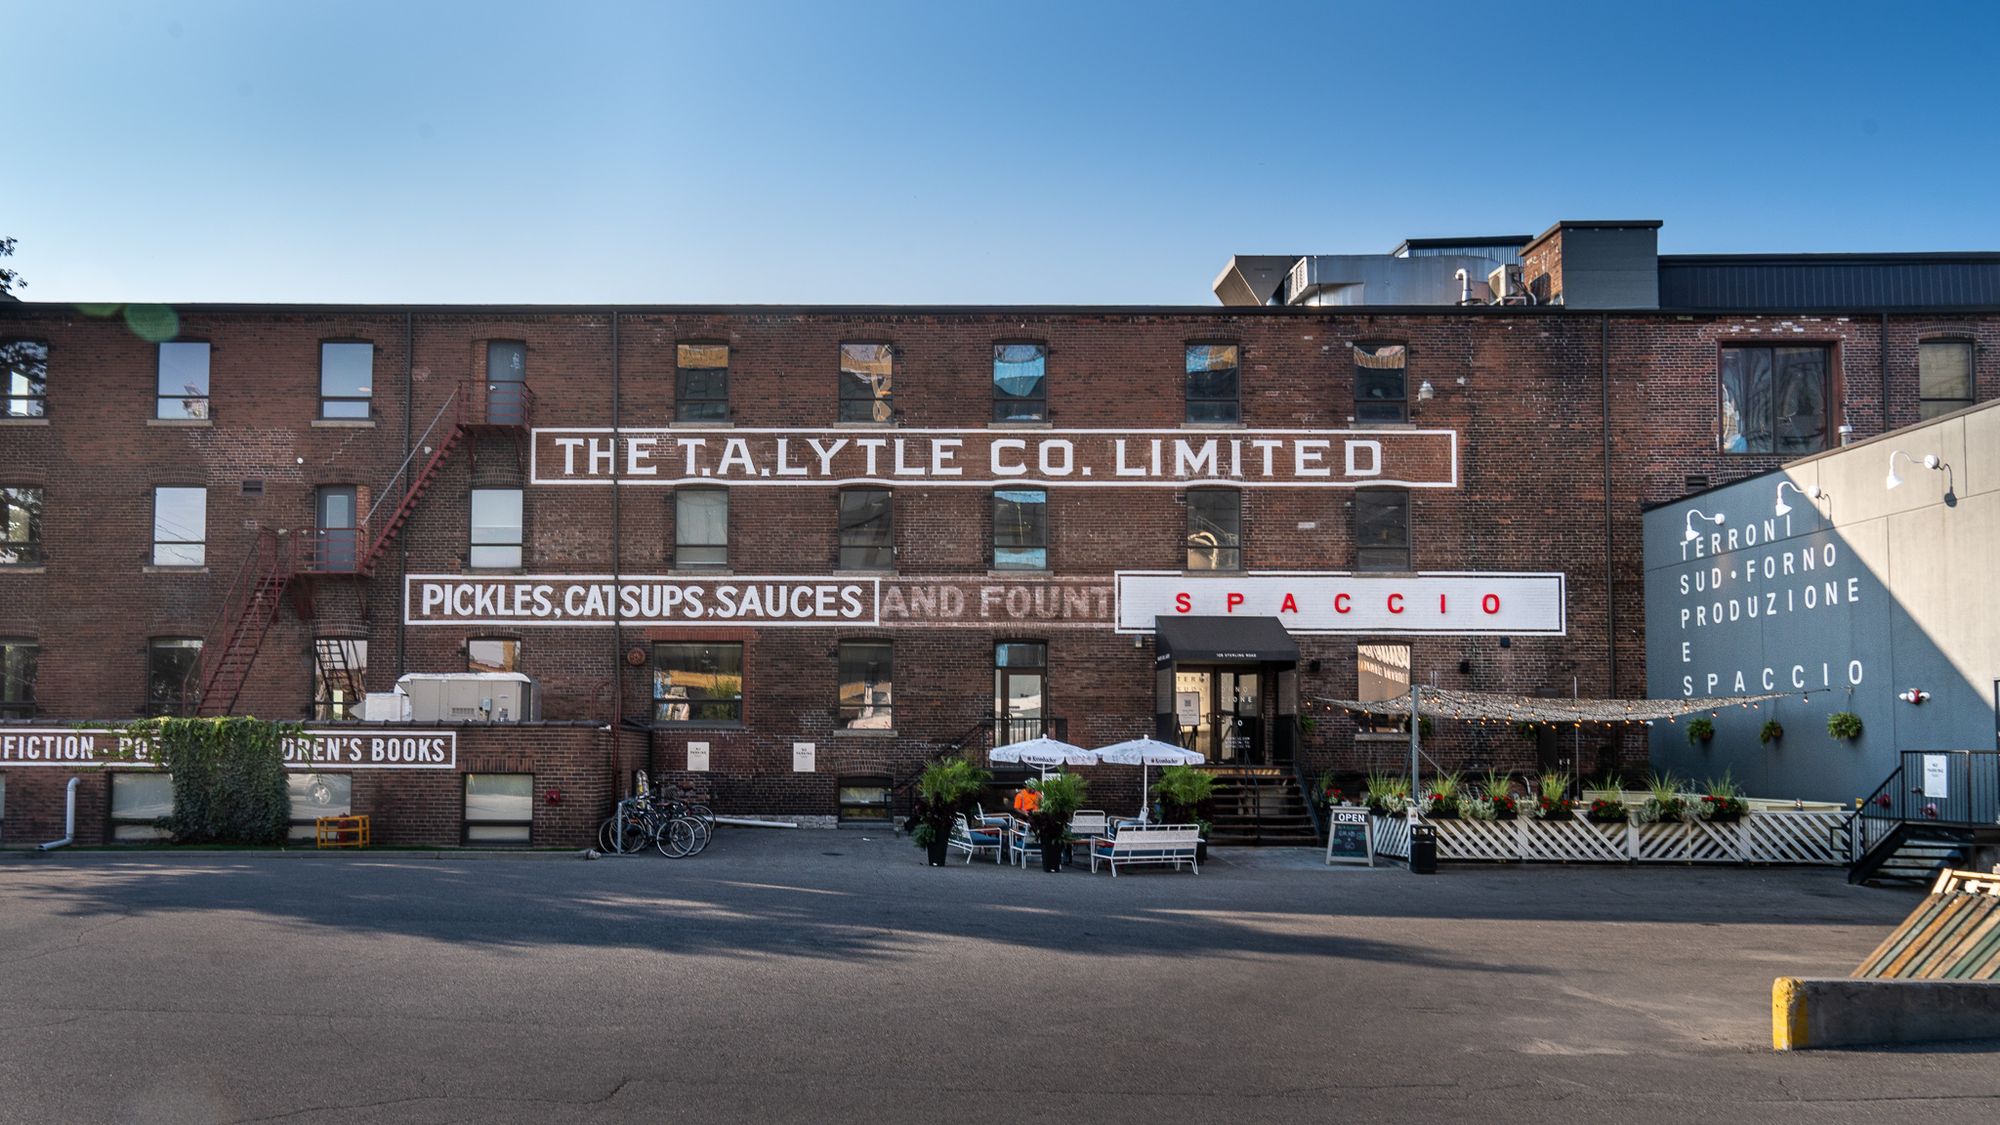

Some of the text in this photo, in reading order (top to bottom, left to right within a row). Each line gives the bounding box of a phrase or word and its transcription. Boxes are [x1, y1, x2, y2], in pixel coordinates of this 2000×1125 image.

[556, 438, 657, 475] THE
[990, 439, 1092, 476] CO.
[1115, 439, 1382, 477] LIMITED
[1680, 514, 1791, 561] TERRONI
[880, 585, 1115, 619] AND FOUNT
[1175, 592, 1501, 615] SPACCIO
[1681, 577, 1859, 629] PRODUZIONE
[1681, 641, 1691, 662] E
[1683, 660, 1863, 696] SPACCIO
[0, 736, 94, 760] FICTION
[371, 738, 445, 762] BOOKS
[1338, 813, 1365, 822] OPEN
